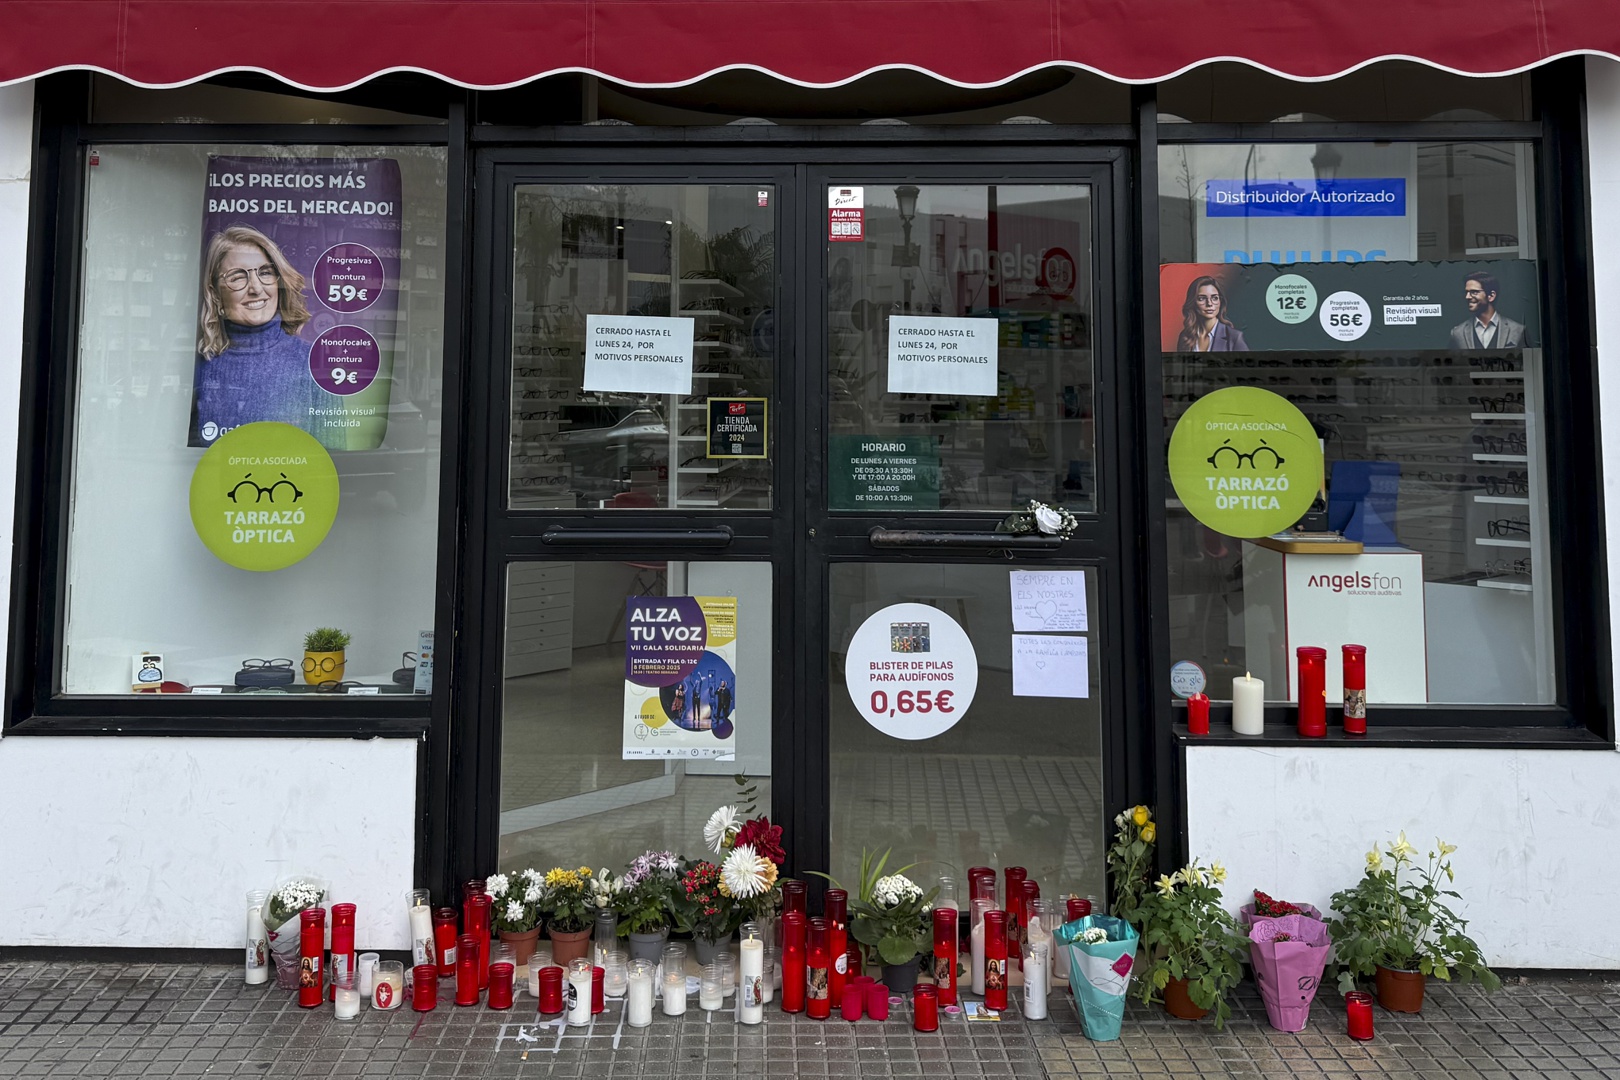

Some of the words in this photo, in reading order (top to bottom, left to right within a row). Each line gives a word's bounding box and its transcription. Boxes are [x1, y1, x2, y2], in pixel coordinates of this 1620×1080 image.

[250, 174, 324, 188] PRECIOS
[329, 171, 366, 189] MÁS
[1216, 190, 1305, 204] Distribuidor
[1310, 190, 1395, 203] Autorizado
[209, 199, 260, 213] BAJOS
[264, 200, 298, 214] DEL
[302, 200, 394, 216] MERCADO!
[832, 210, 861, 218] Alarma
[327, 256, 372, 265] Progresivas
[328, 284, 368, 302] 59€
[1276, 296, 1306, 310] 12€
[1330, 314, 1362, 326] 56€
[596, 327, 633, 335] CERRADO
[898, 328, 936, 336] CERRADO
[622, 341, 634, 349] 24,
[925, 342, 937, 350] 24,
[595, 353, 632, 361] MOTIVOS
[634, 354, 683, 363] PERSONALES
[938, 355, 988, 364] PERSONALES
[331, 367, 358, 385] 9€
[308, 407, 348, 416] Revisión
[351, 407, 376, 415] visual
[324, 419, 360, 427] incluida
[725, 416, 750, 424] TIENDA
[716, 424, 758, 432] CERTIFICADA
[1241, 422, 1287, 431] ASOCIADA
[862, 443, 906, 452] HORARIO
[262, 456, 308, 465] ASOCIADA
[1206, 474, 1289, 491] TARRAZÓ
[1216, 492, 1280, 510] ÒPTICA
[224, 507, 305, 525] TARRAZÓ
[232, 526, 294, 543] ÒPTICA
[1017, 575, 1056, 586] SEMPRE
[1061, 576, 1073, 585] EN
[1308, 571, 1402, 592] Angelsfon
[1018, 591, 1032, 599] ELS
[631, 608, 681, 622] ALZA
[631, 627, 655, 641] TU
[661, 627, 702, 641] VOZ
[898, 671, 954, 681] AUDÍFONOS
[871, 690, 954, 717] 0,65€
